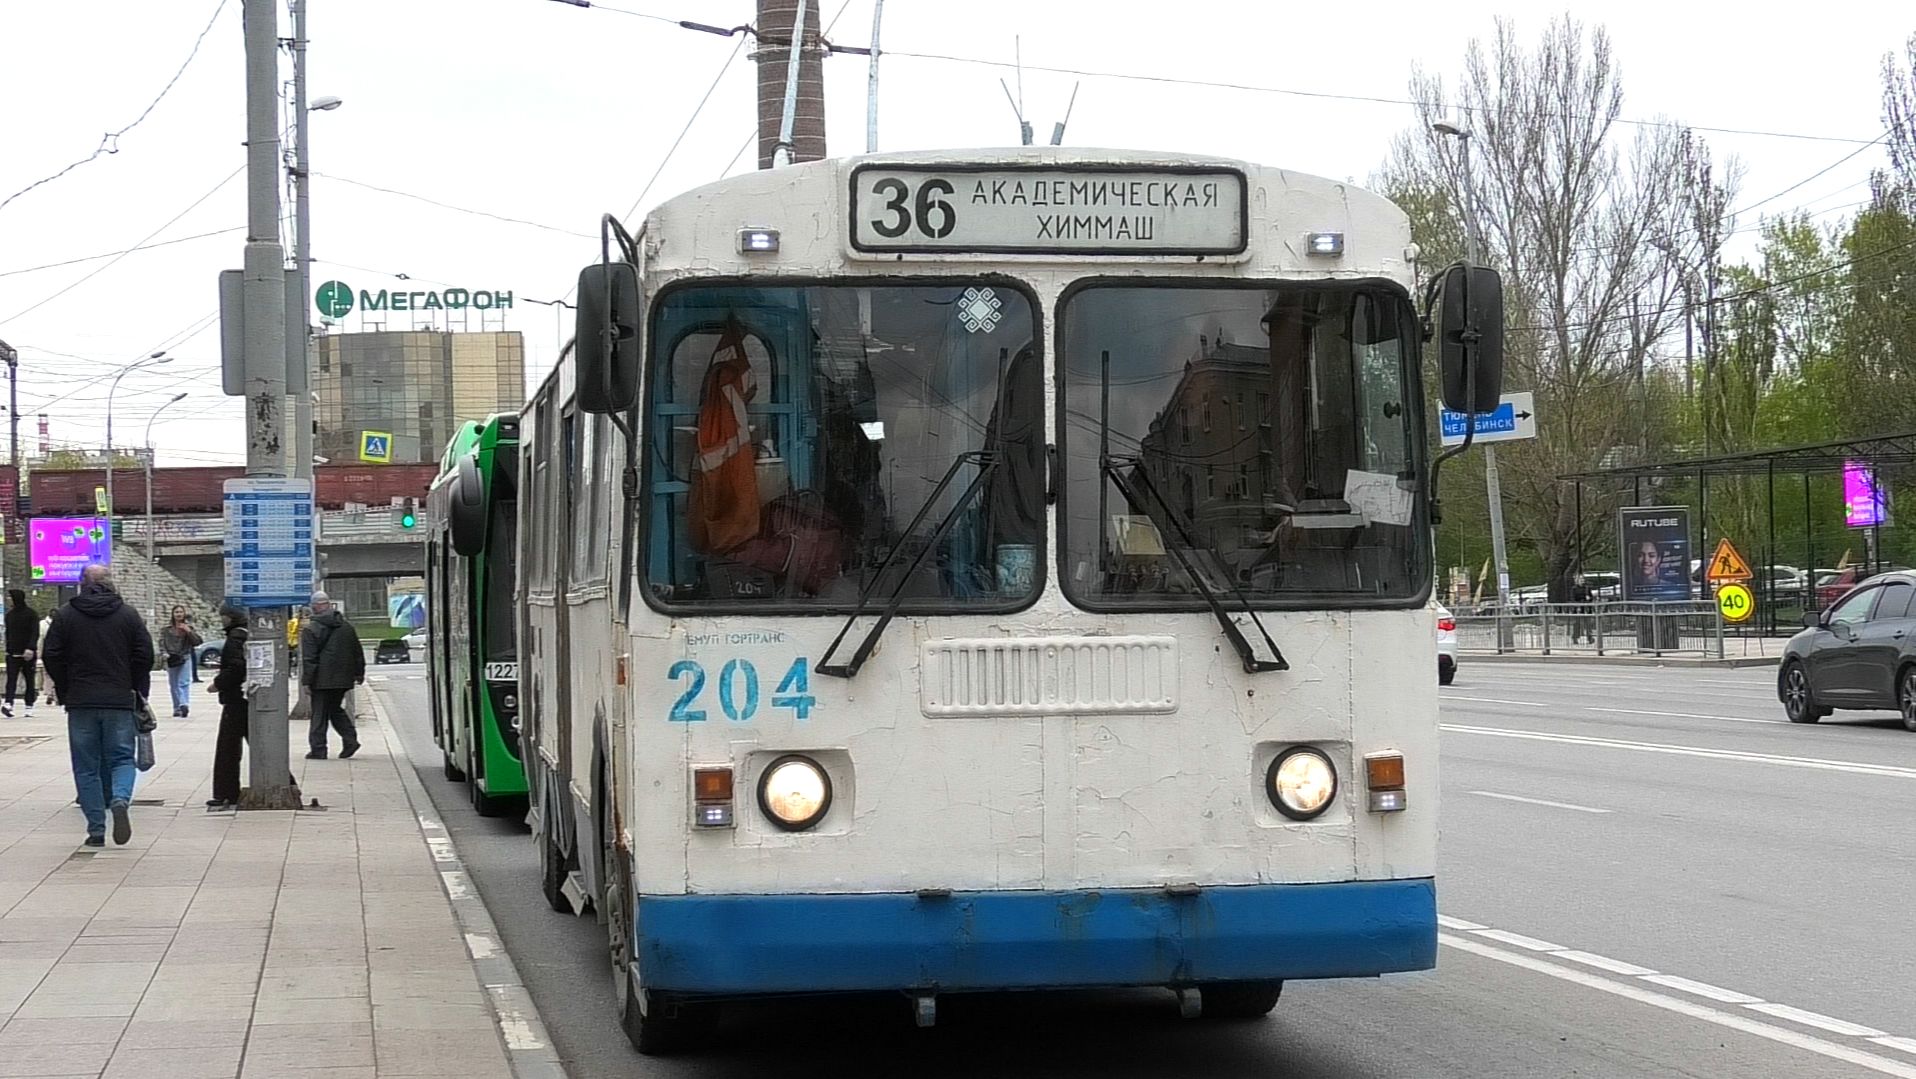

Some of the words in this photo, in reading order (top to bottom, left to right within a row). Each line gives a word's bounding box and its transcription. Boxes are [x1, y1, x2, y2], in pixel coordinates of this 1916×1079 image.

[972, 180, 1217, 207] АКАДЕМИЧЕСКАЯ
[871, 177, 956, 239] 36
[1037, 215, 1153, 240] ХИММАШ
[1444, 419, 1513, 433] ЧЕЛБИНСК
[1630, 518, 1679, 528] RUTUBE
[1722, 594, 1744, 609] 40
[725, 632, 784, 645] ГОРТРАНС
[667, 657, 816, 721] 204
